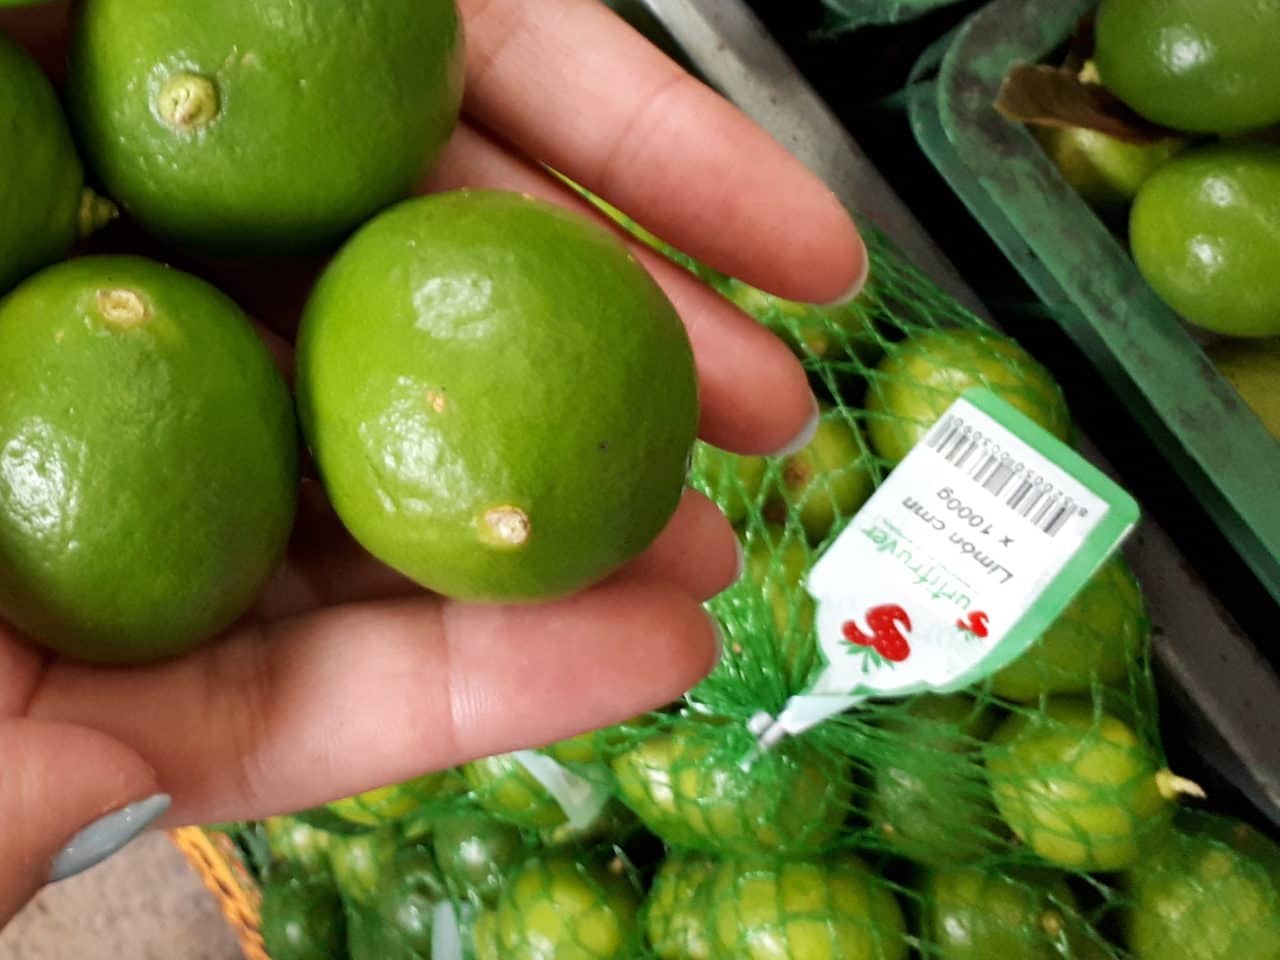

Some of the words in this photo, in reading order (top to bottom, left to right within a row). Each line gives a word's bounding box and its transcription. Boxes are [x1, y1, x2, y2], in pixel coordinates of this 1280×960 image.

[901, 496, 945, 530] cmn
[936, 487, 992, 534] 1000g
[949, 532, 1013, 583] Limón
[999, 535, 1013, 548] x
